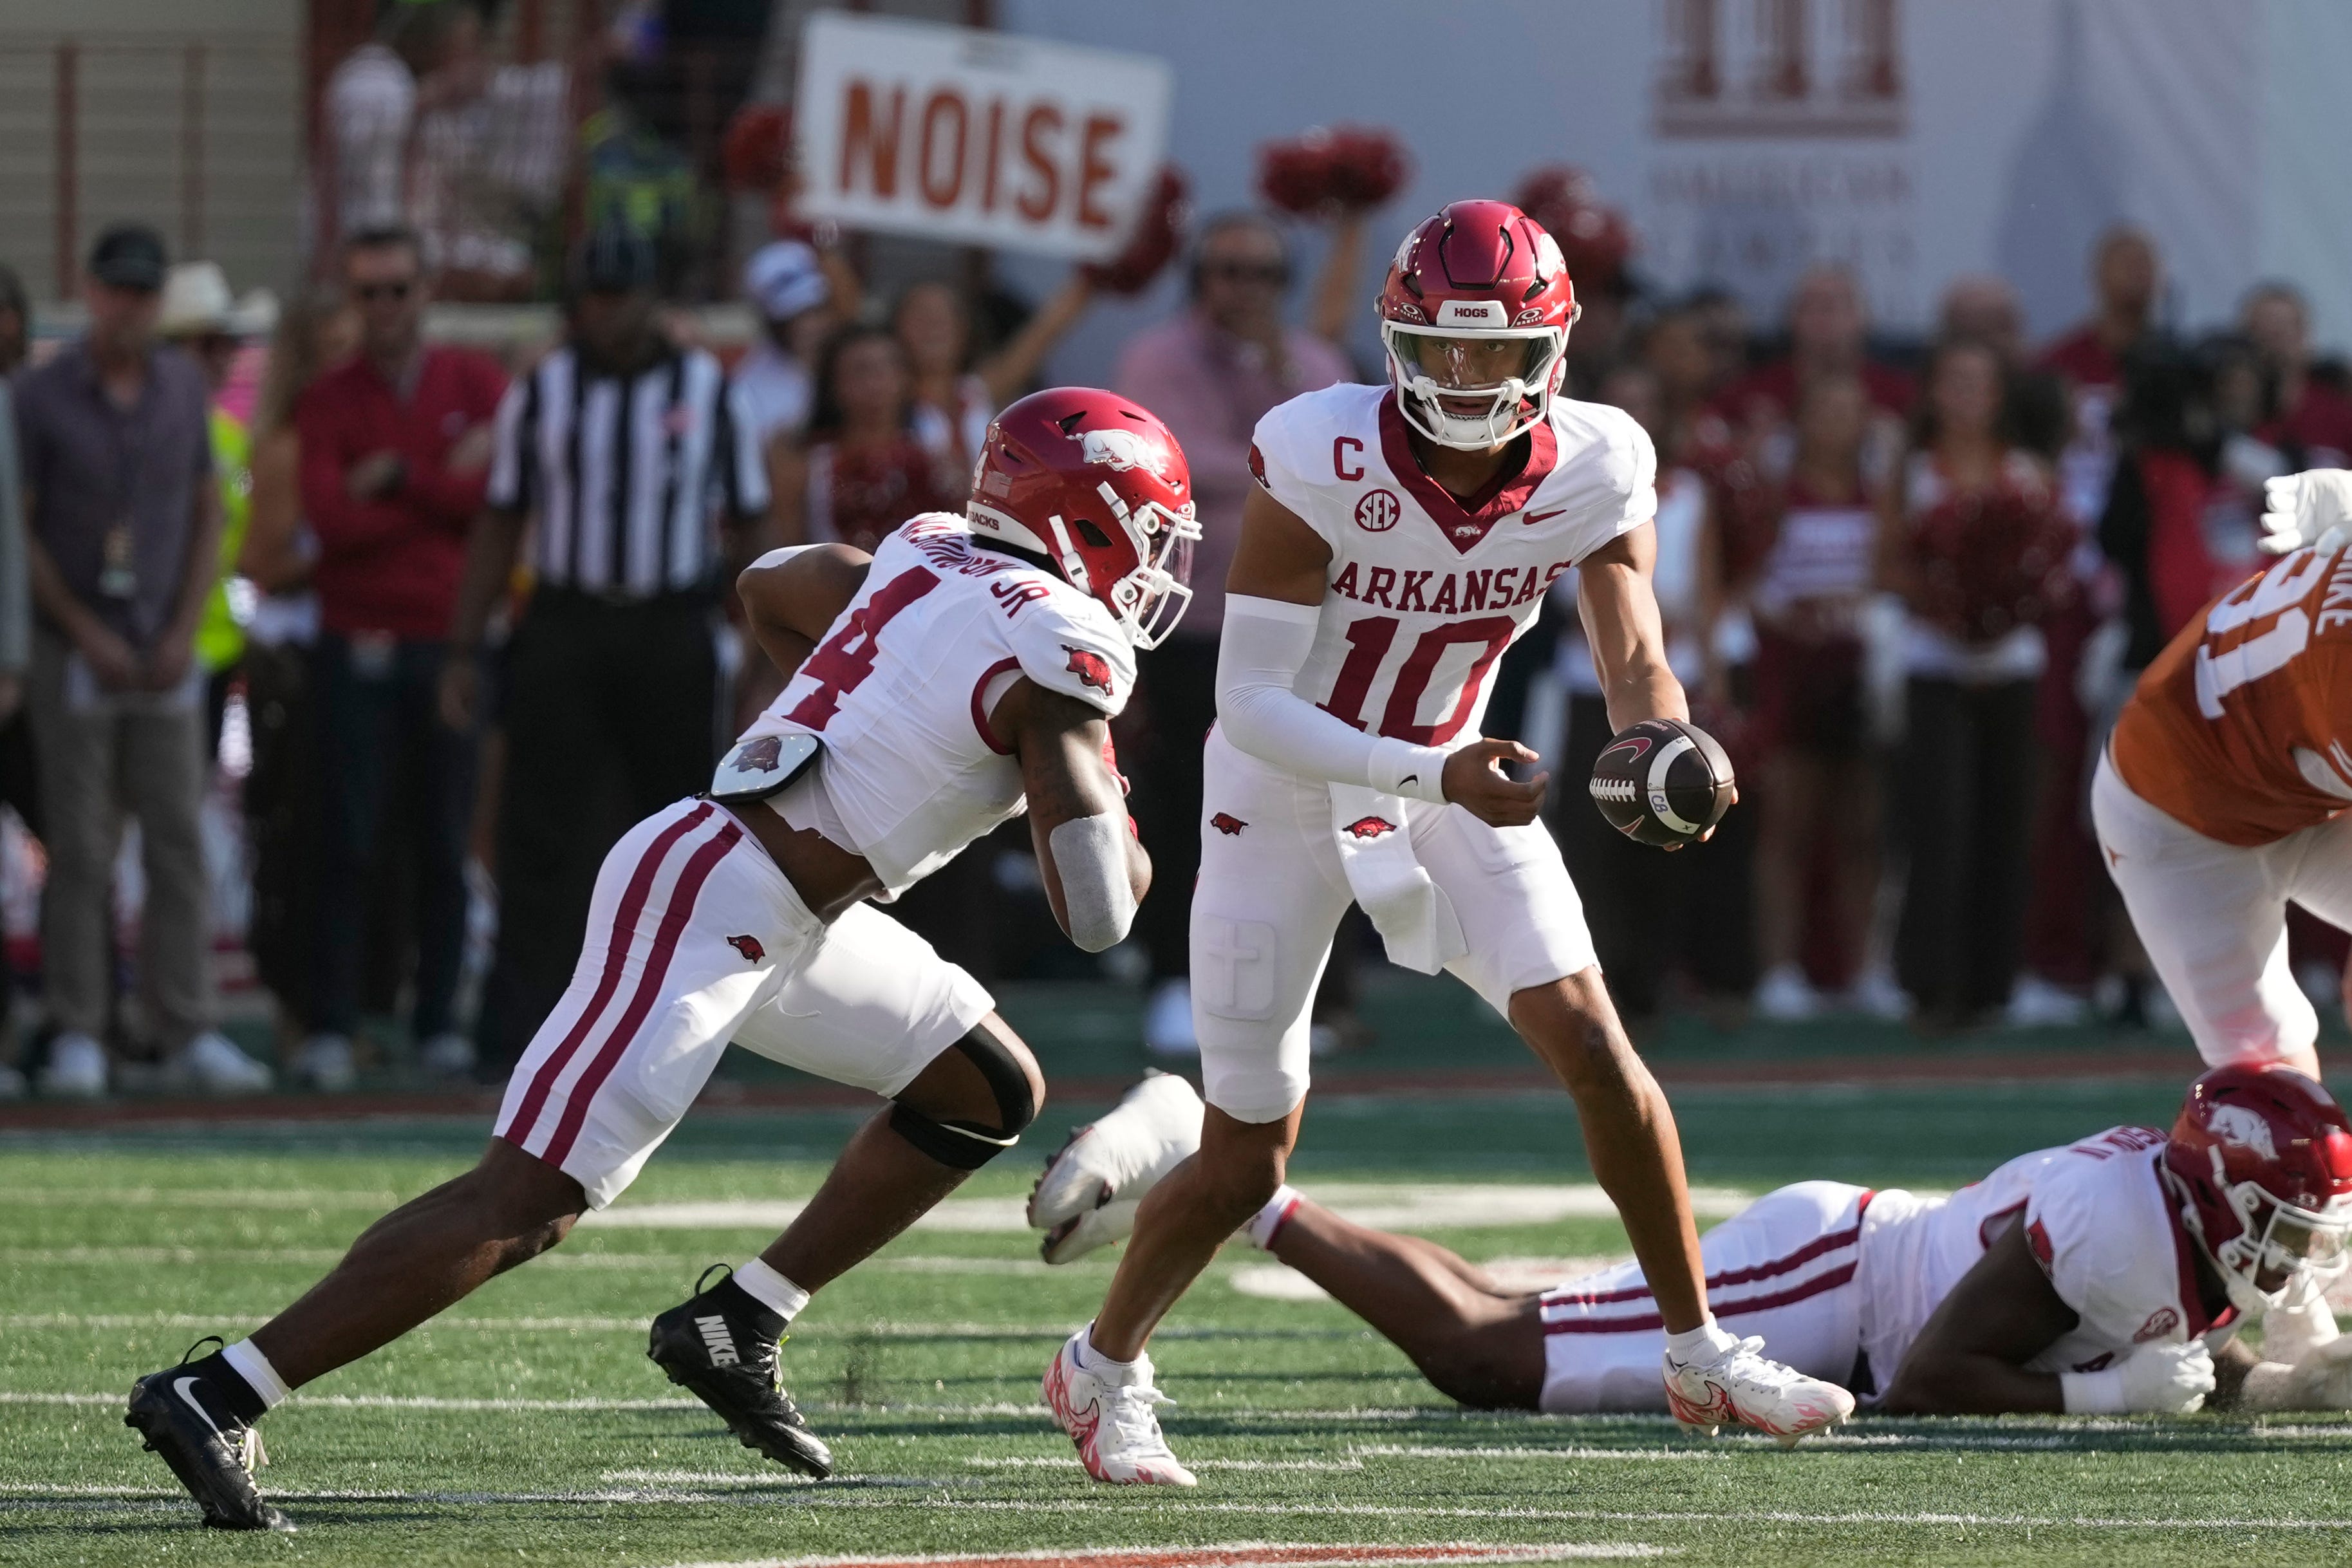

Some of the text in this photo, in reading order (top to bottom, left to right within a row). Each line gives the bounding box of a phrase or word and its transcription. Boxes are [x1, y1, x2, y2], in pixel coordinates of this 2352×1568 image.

[838, 77, 1126, 230] NOISE
[1454, 307, 1489, 318] HOGS
[1334, 436, 1365, 481] C
[1359, 492, 1397, 528] SEC
[990, 581, 1050, 619] JR
[1330, 560, 1574, 615] ARKANSAS
[781, 565, 942, 732] 4
[2195, 547, 2329, 720] 91
[1314, 615, 1517, 749] 10
[695, 1314, 740, 1367] NIKE
